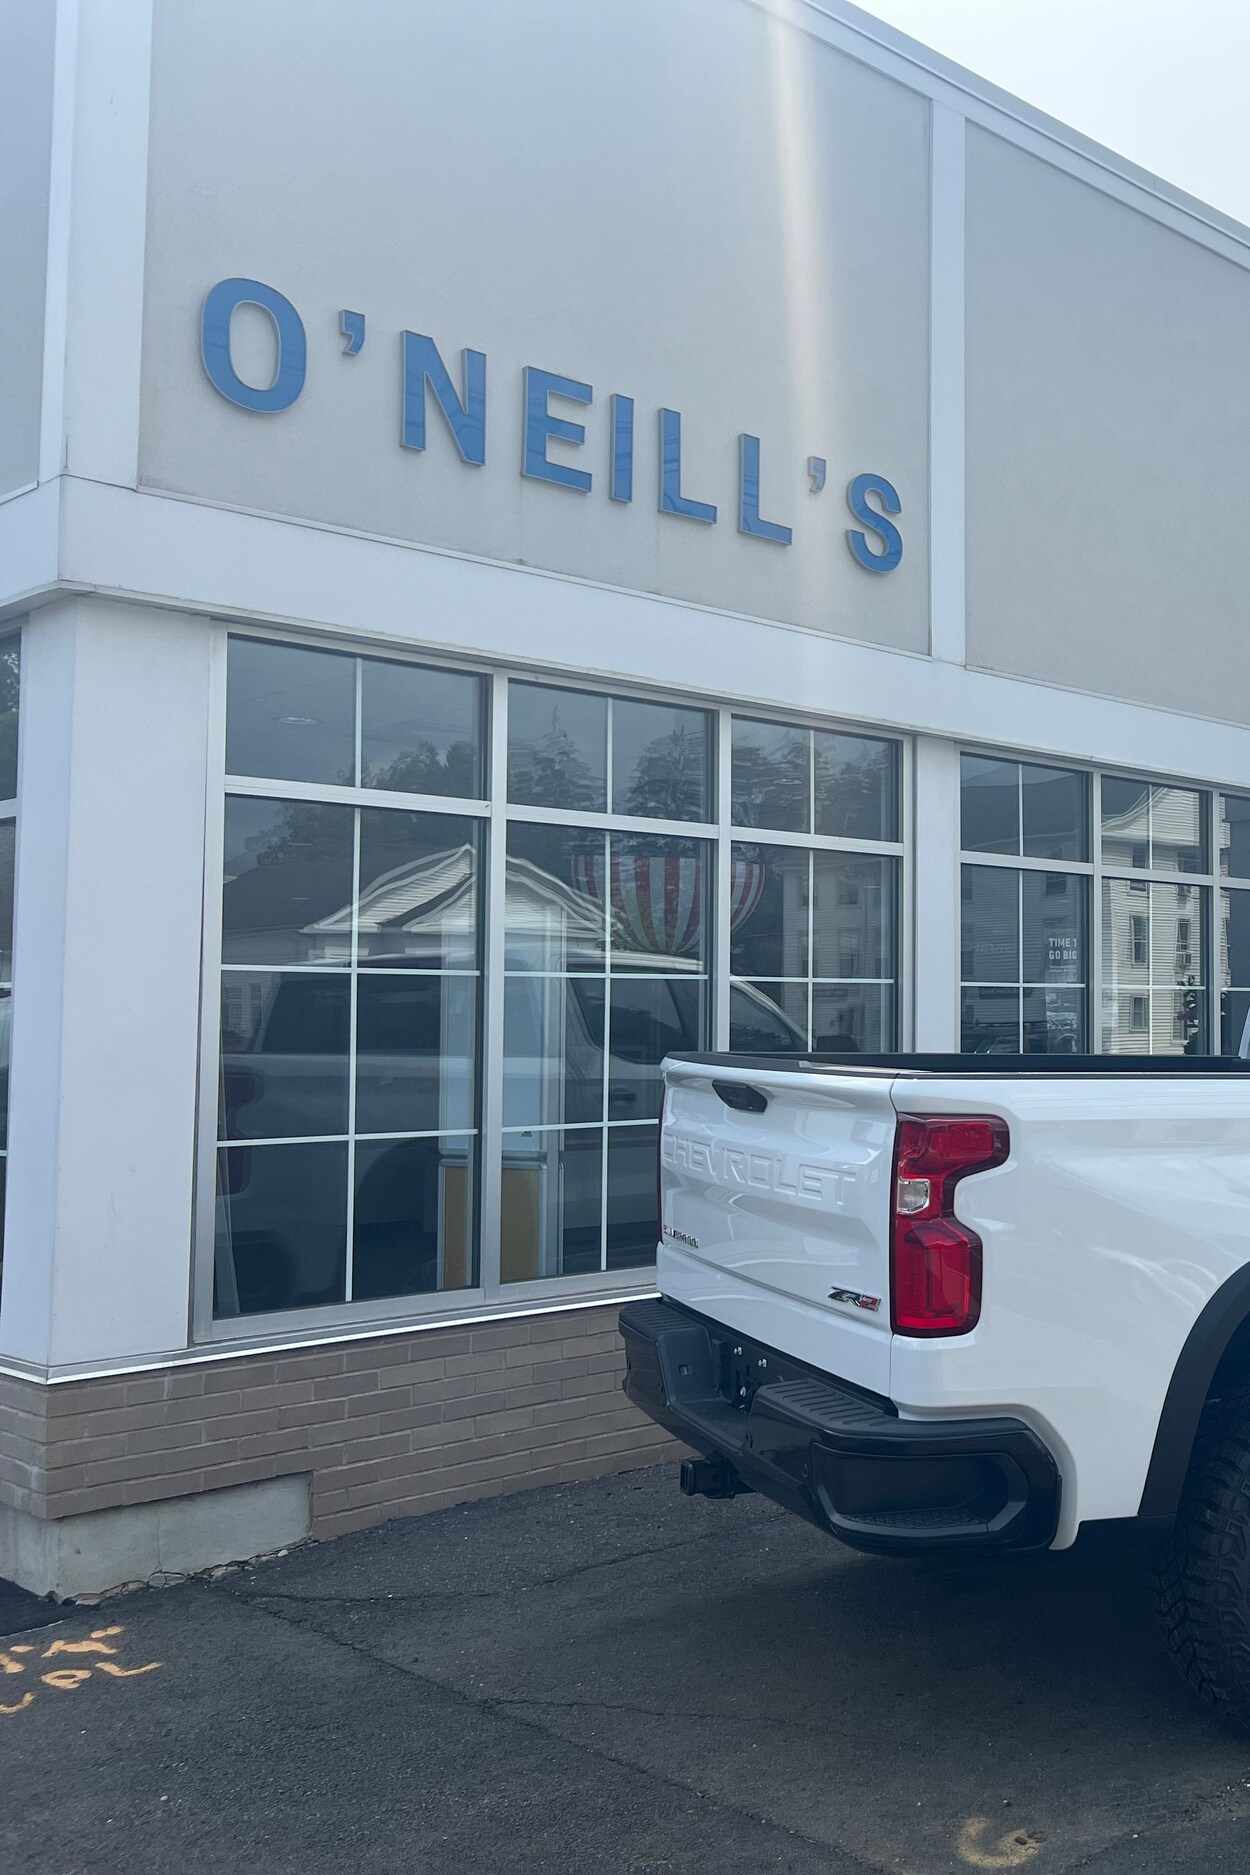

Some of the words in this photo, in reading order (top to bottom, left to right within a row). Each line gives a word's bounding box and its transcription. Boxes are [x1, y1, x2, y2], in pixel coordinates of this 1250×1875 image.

[200, 276, 904, 575] O'NEILL'S
[1048, 937, 1071, 948] TIME
[1048, 950, 1061, 960] GO
[662, 1131, 857, 1206] CHEVROLET
[827, 1285, 882, 1312] ZR2
